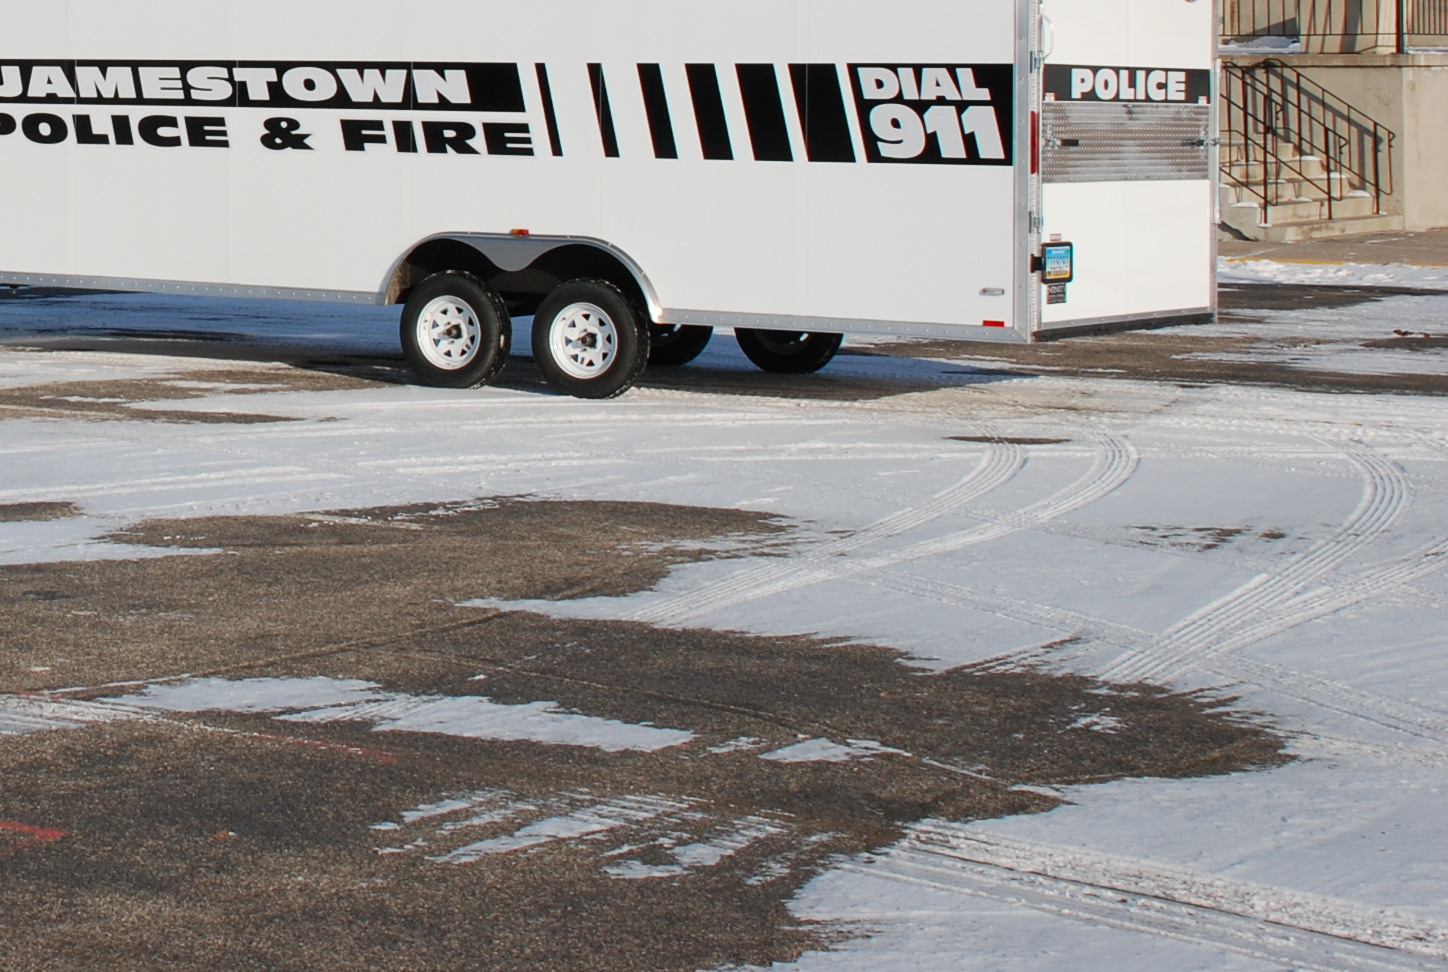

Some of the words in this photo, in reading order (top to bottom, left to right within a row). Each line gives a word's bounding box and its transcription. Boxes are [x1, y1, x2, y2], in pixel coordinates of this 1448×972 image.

[857, 67, 992, 101] DIAL
[1071, 68, 1187, 101] POLICE
[260, 117, 315, 150] &
[339, 119, 535, 156] FIRE
[869, 103, 1006, 159] 911
